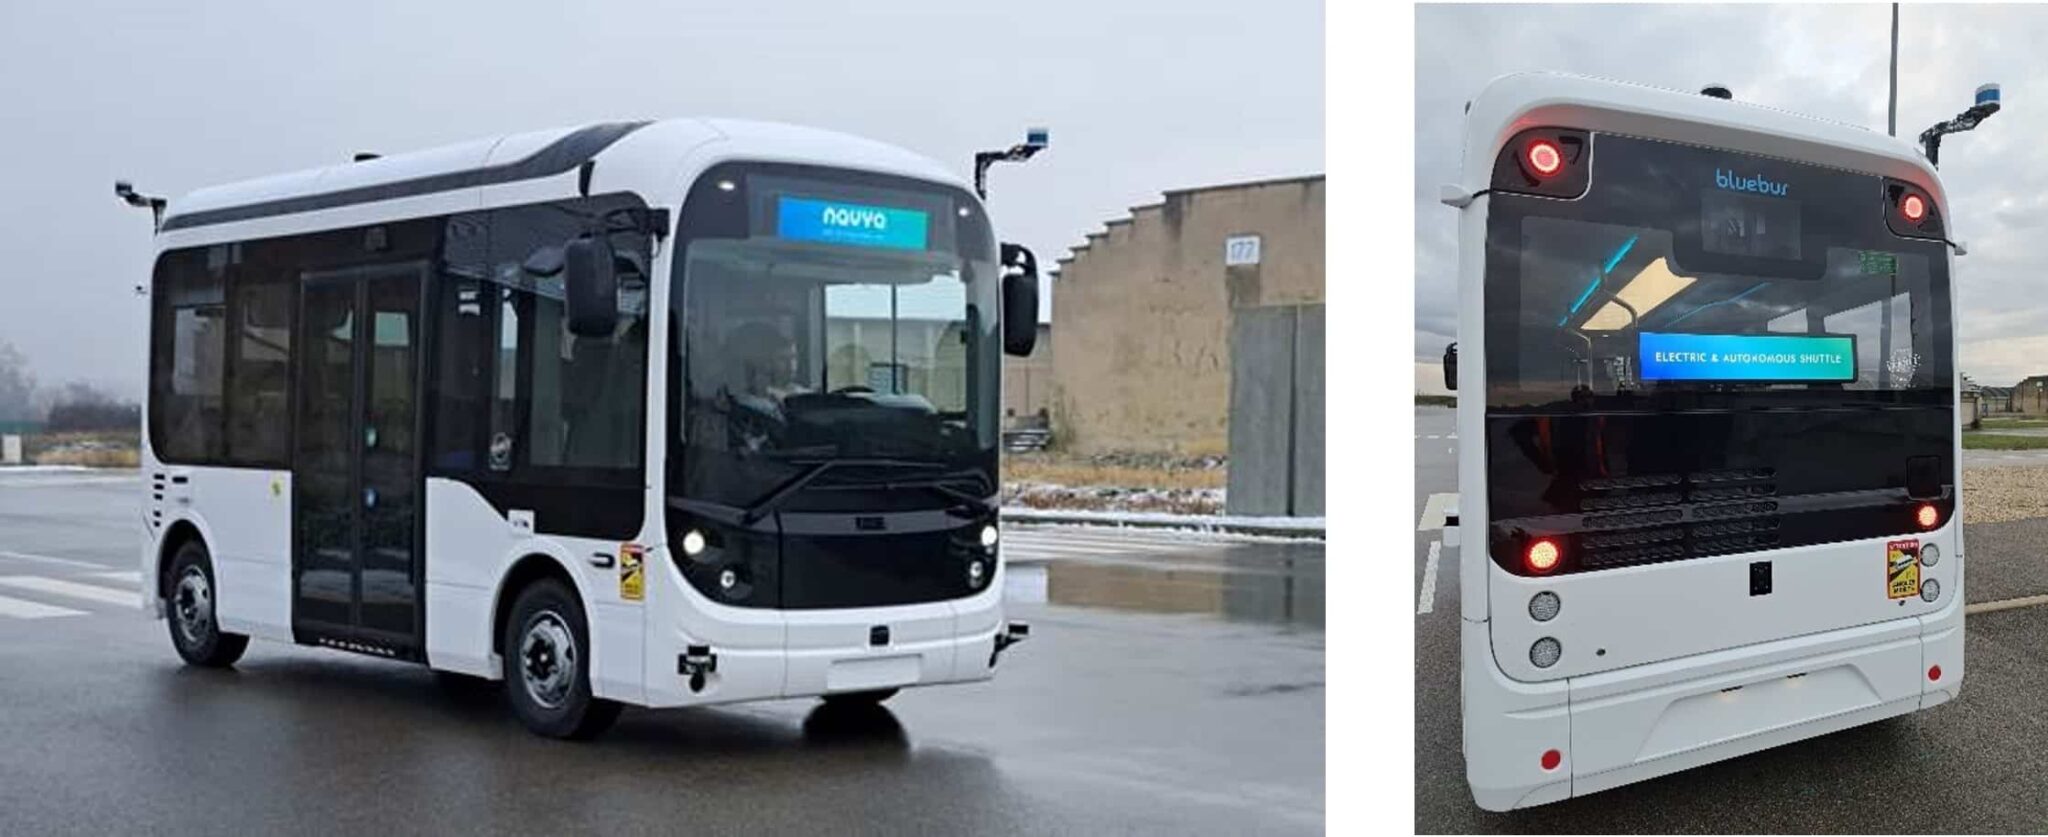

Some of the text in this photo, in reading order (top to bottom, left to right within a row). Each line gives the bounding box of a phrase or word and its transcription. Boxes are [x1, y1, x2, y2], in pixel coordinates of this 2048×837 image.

[1715, 167, 1788, 196] bluebus
[1655, 351, 1842, 364] ELECTRIC & AUTONOMOUS SHUTTLE
